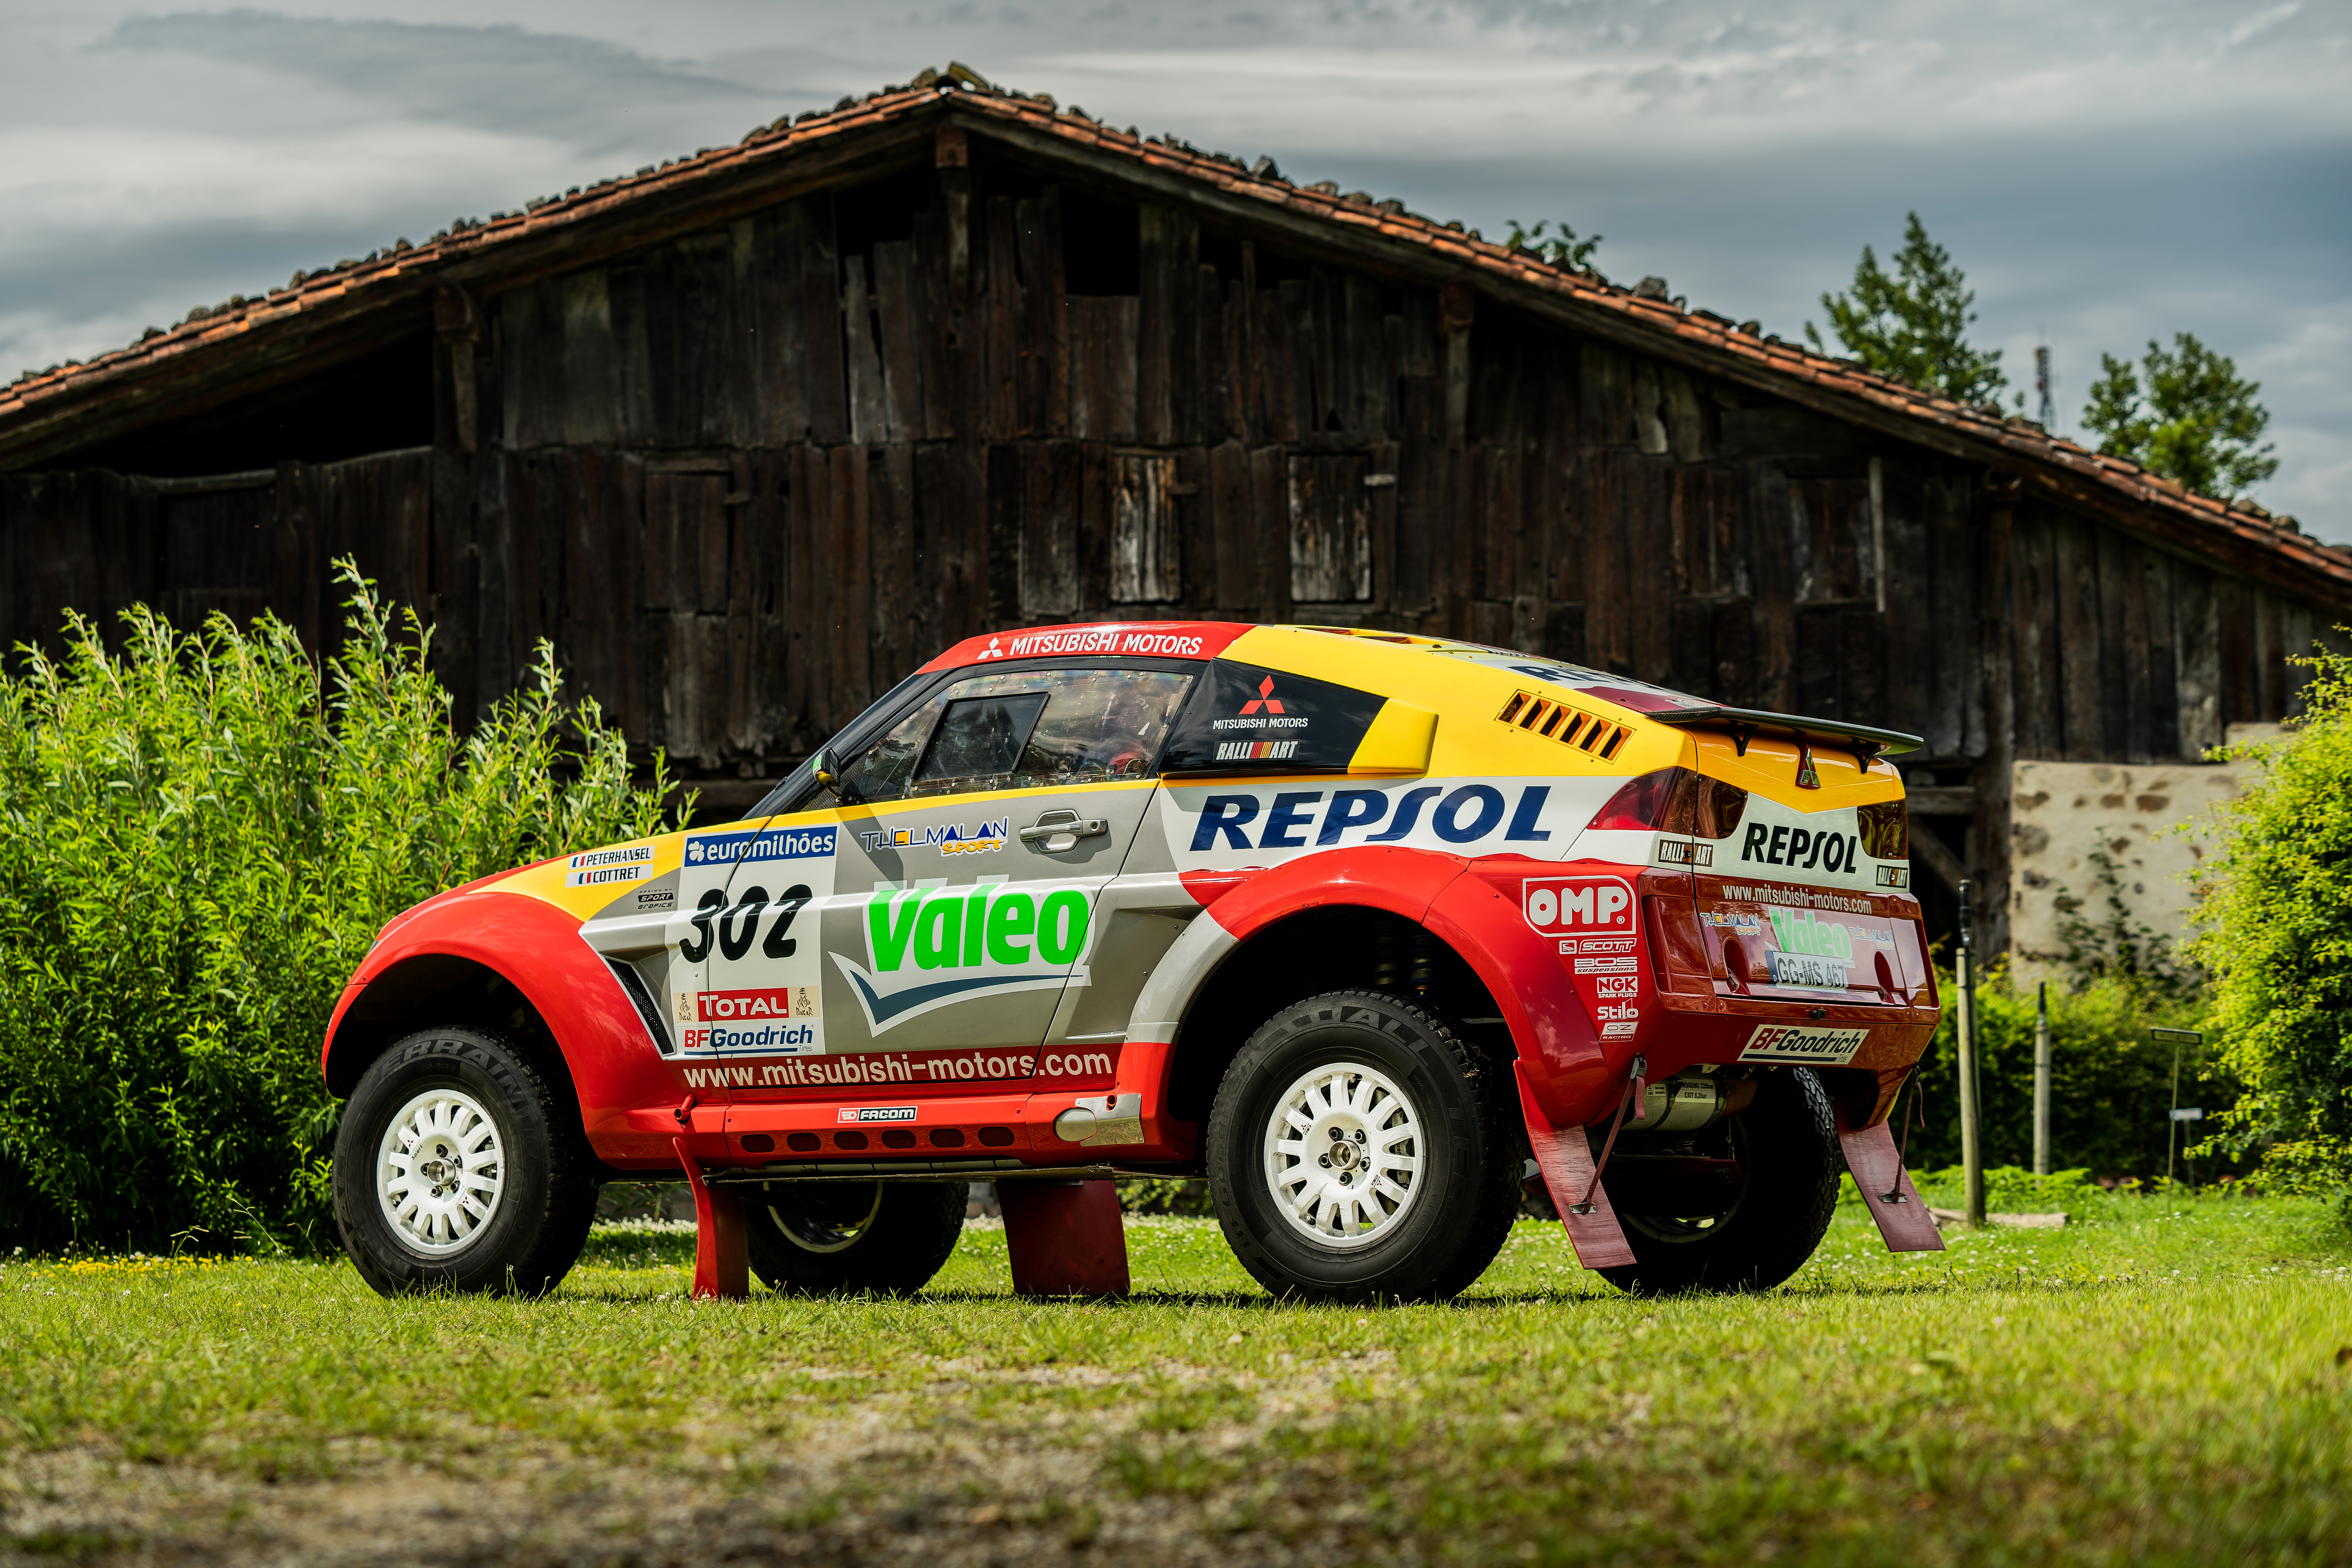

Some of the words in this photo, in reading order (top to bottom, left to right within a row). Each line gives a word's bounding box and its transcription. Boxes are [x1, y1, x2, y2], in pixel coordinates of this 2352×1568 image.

[1010, 633, 1120, 656] MITSUBISHI
[1122, 634, 1203, 655] MOTORS
[1213, 719, 1266, 730] MITSUBISHI
[1269, 718, 1308, 728] MOTORS
[1189, 784, 1552, 851] REPSOL
[587, 847, 650, 866] PETERHANSEL
[708, 832, 833, 860] euromilhões
[942, 839, 1006, 855] SPORT
[1741, 822, 1858, 874] REPSOL
[593, 867, 640, 883] COTTRET
[1529, 886, 1628, 926] OMP
[1722, 884, 1872, 914] www.mitsubishi-motors.com
[679, 884, 813, 963] 302
[869, 884, 1089, 972] Valeo
[1737, 926, 1761, 936] SPORT
[1582, 941, 1633, 951] SCOTT
[1574, 956, 1638, 967] BOS
[1598, 977, 1637, 992] NGK
[1826, 964, 1846, 988] 467
[679, 1012, 692, 1021] DAKAR
[699, 995, 787, 1017] TOTAL
[796, 1007, 813, 1016] DAKAR
[1597, 1001, 1639, 1019] Stilo
[684, 1024, 813, 1048] BFGoodrich
[1345, 1009, 1429, 1067] ALL
[1748, 1028, 1861, 1054] BFGoodrich
[683, 1052, 1112, 1088] www.mitsubishi-motors.com
[860, 1109, 914, 1120] FACOM
